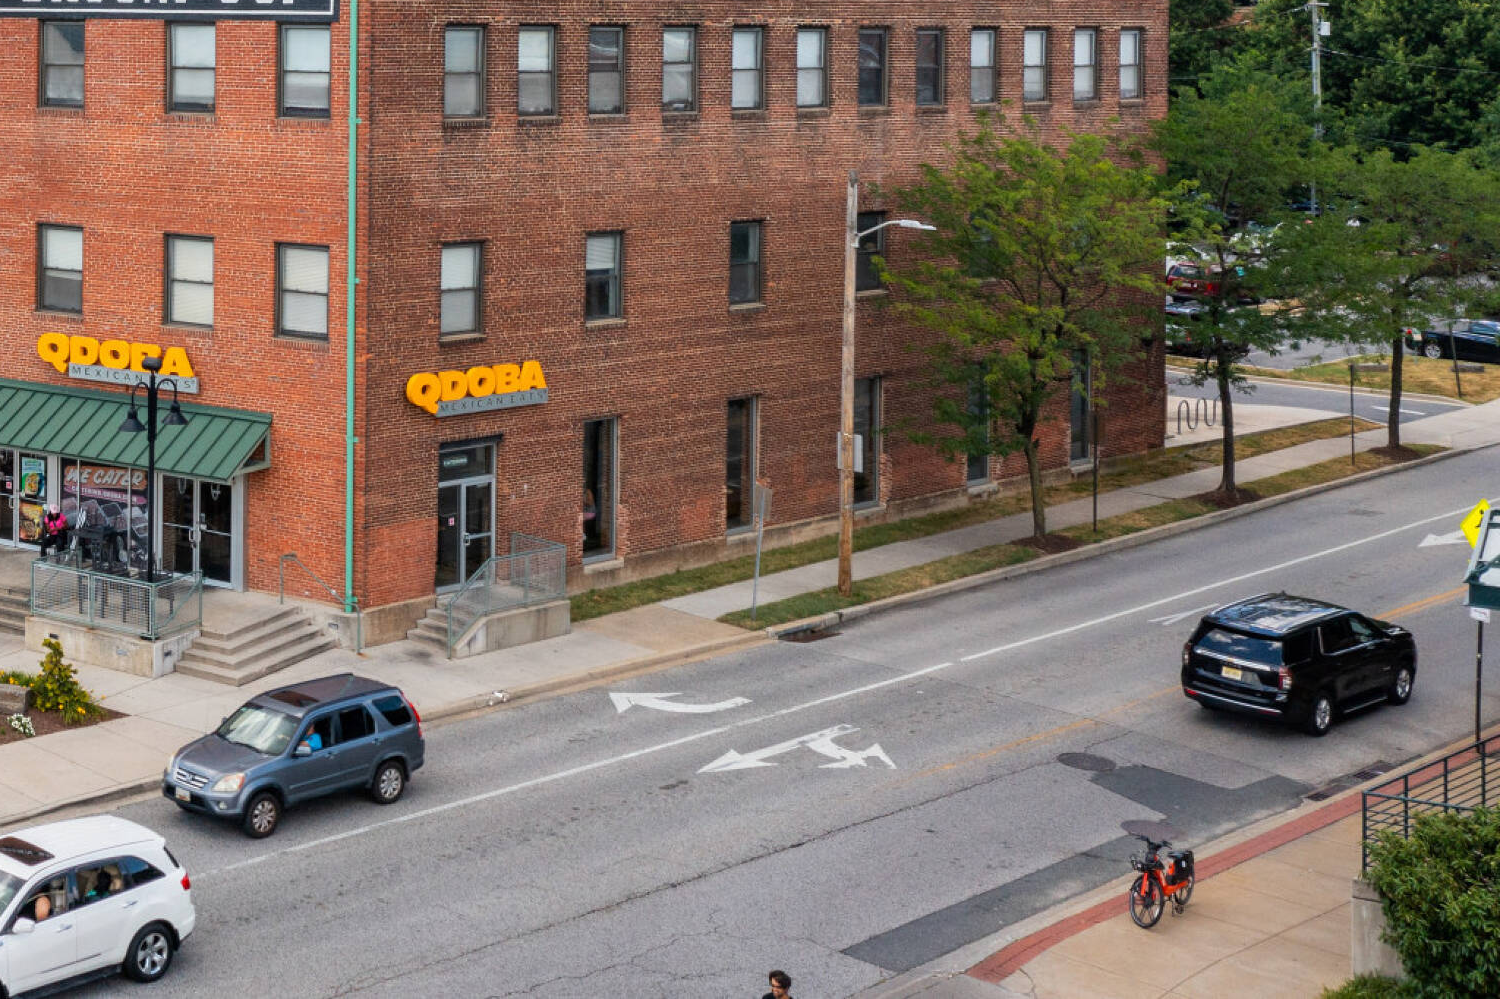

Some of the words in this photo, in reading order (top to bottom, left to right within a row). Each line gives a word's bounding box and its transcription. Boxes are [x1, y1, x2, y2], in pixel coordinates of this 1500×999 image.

[37, 332, 195, 378] QDOBA
[70, 365, 143, 384] MEXICAN
[406, 360, 548, 416] QDOBA
[440, 397, 504, 412] MEXICAN
[510, 391, 544, 404] EATS
[66, 467, 92, 485] WE
